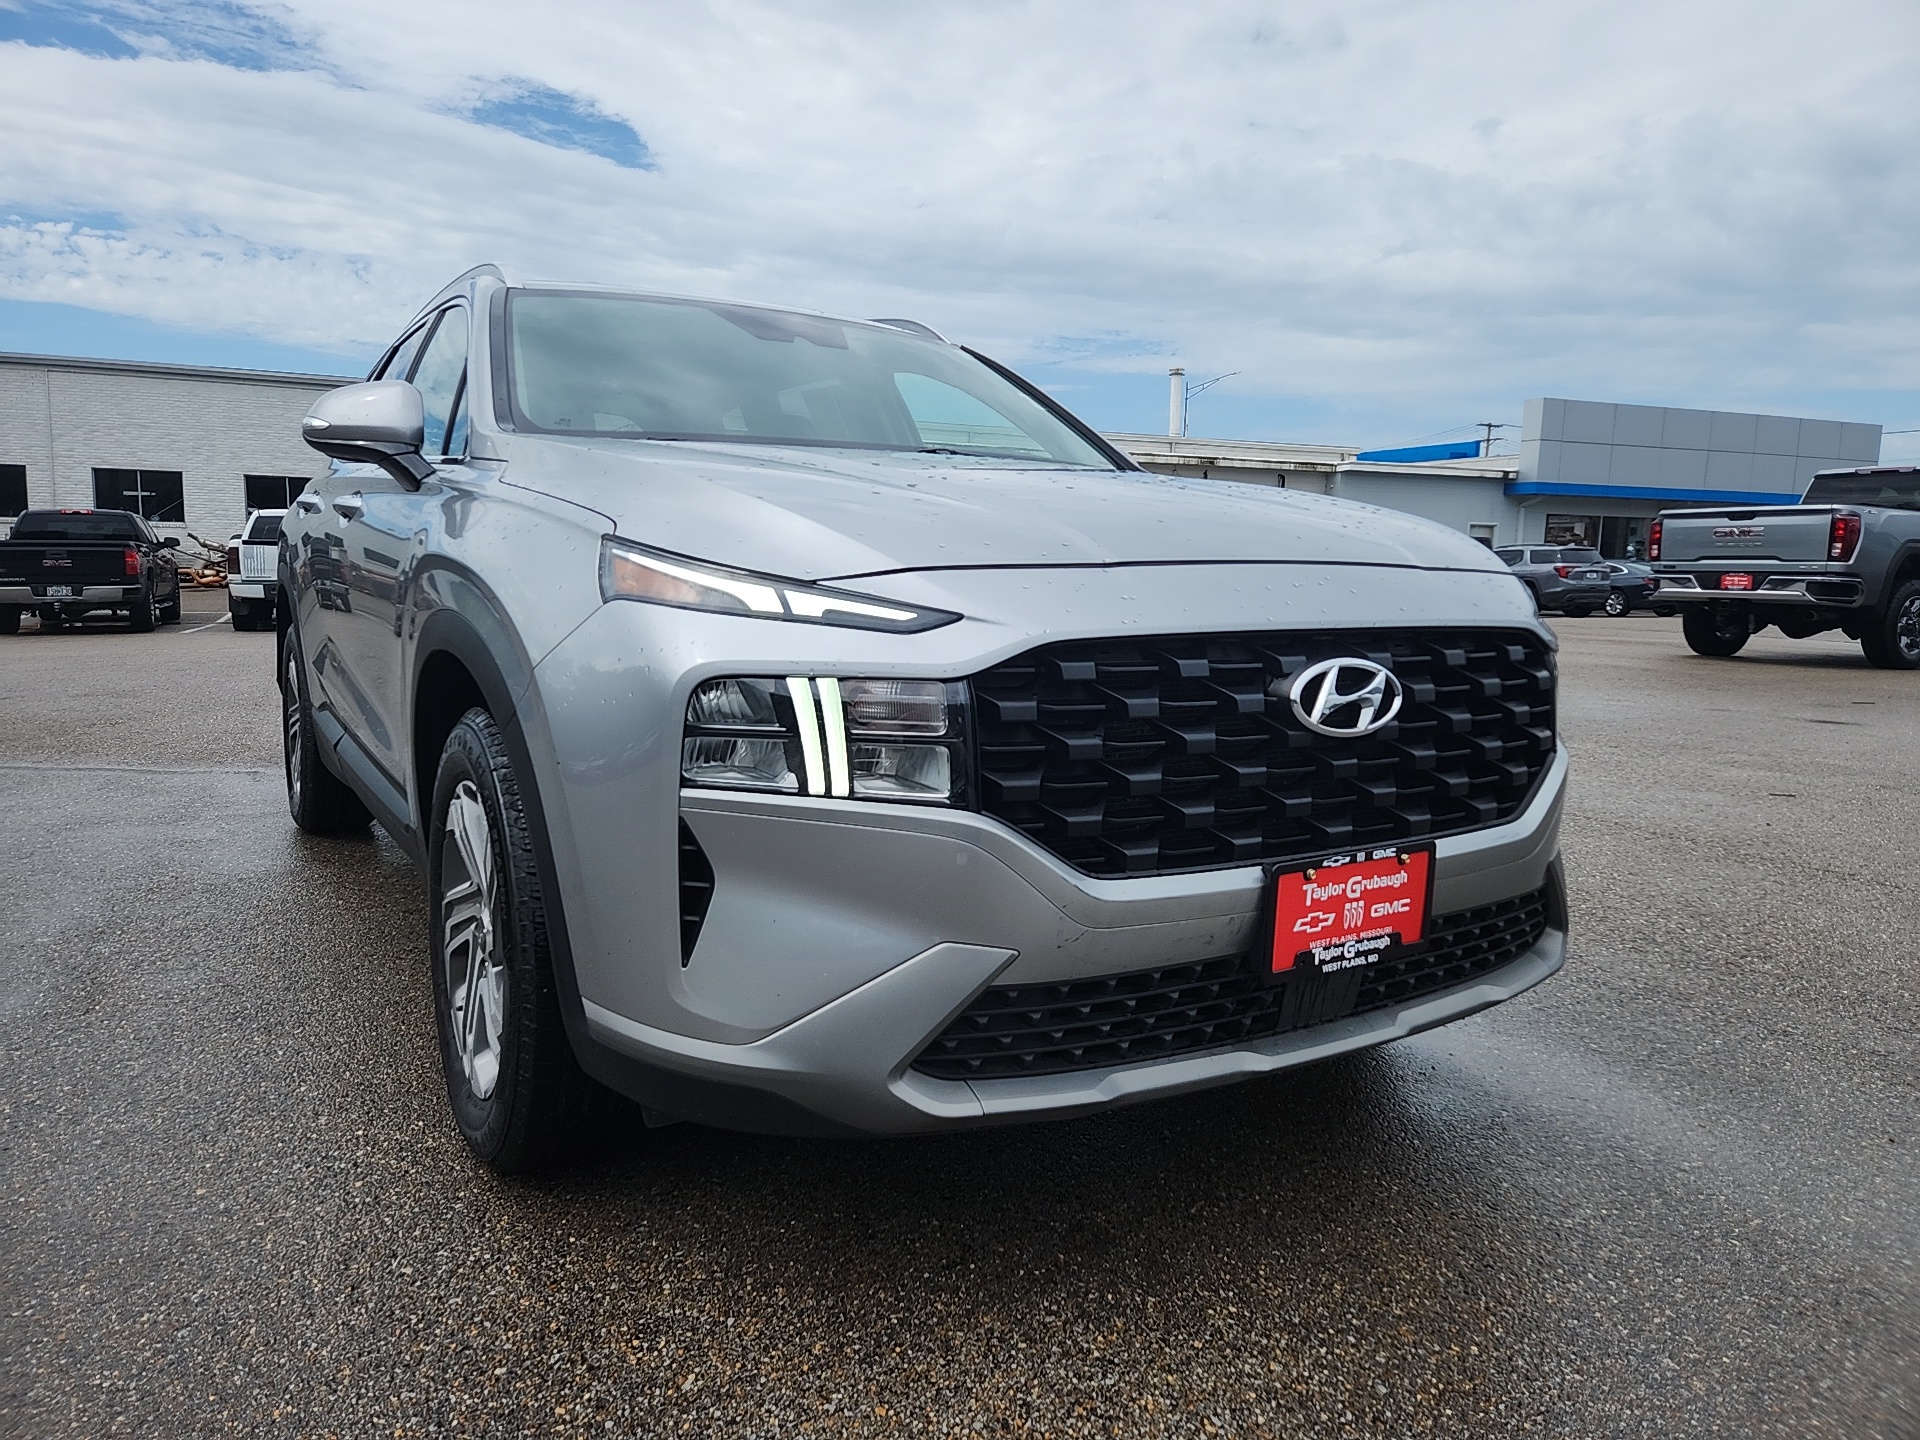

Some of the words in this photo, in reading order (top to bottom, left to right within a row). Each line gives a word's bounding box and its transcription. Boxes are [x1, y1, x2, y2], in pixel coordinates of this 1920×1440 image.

[1372, 847, 1397, 859] GMC
[1302, 881, 1346, 907] Taylor
[1345, 869, 1408, 899] Grubaugh
[1370, 898, 1411, 917] GMC
[1309, 938, 1331, 949] WEST
[1360, 926, 1393, 940] MISSOURI
[1312, 944, 1344, 966] Taylor
[1343, 935, 1391, 959] Grubaugh
[1321, 961, 1341, 973] WEST
[1367, 953, 1379, 963] MO
